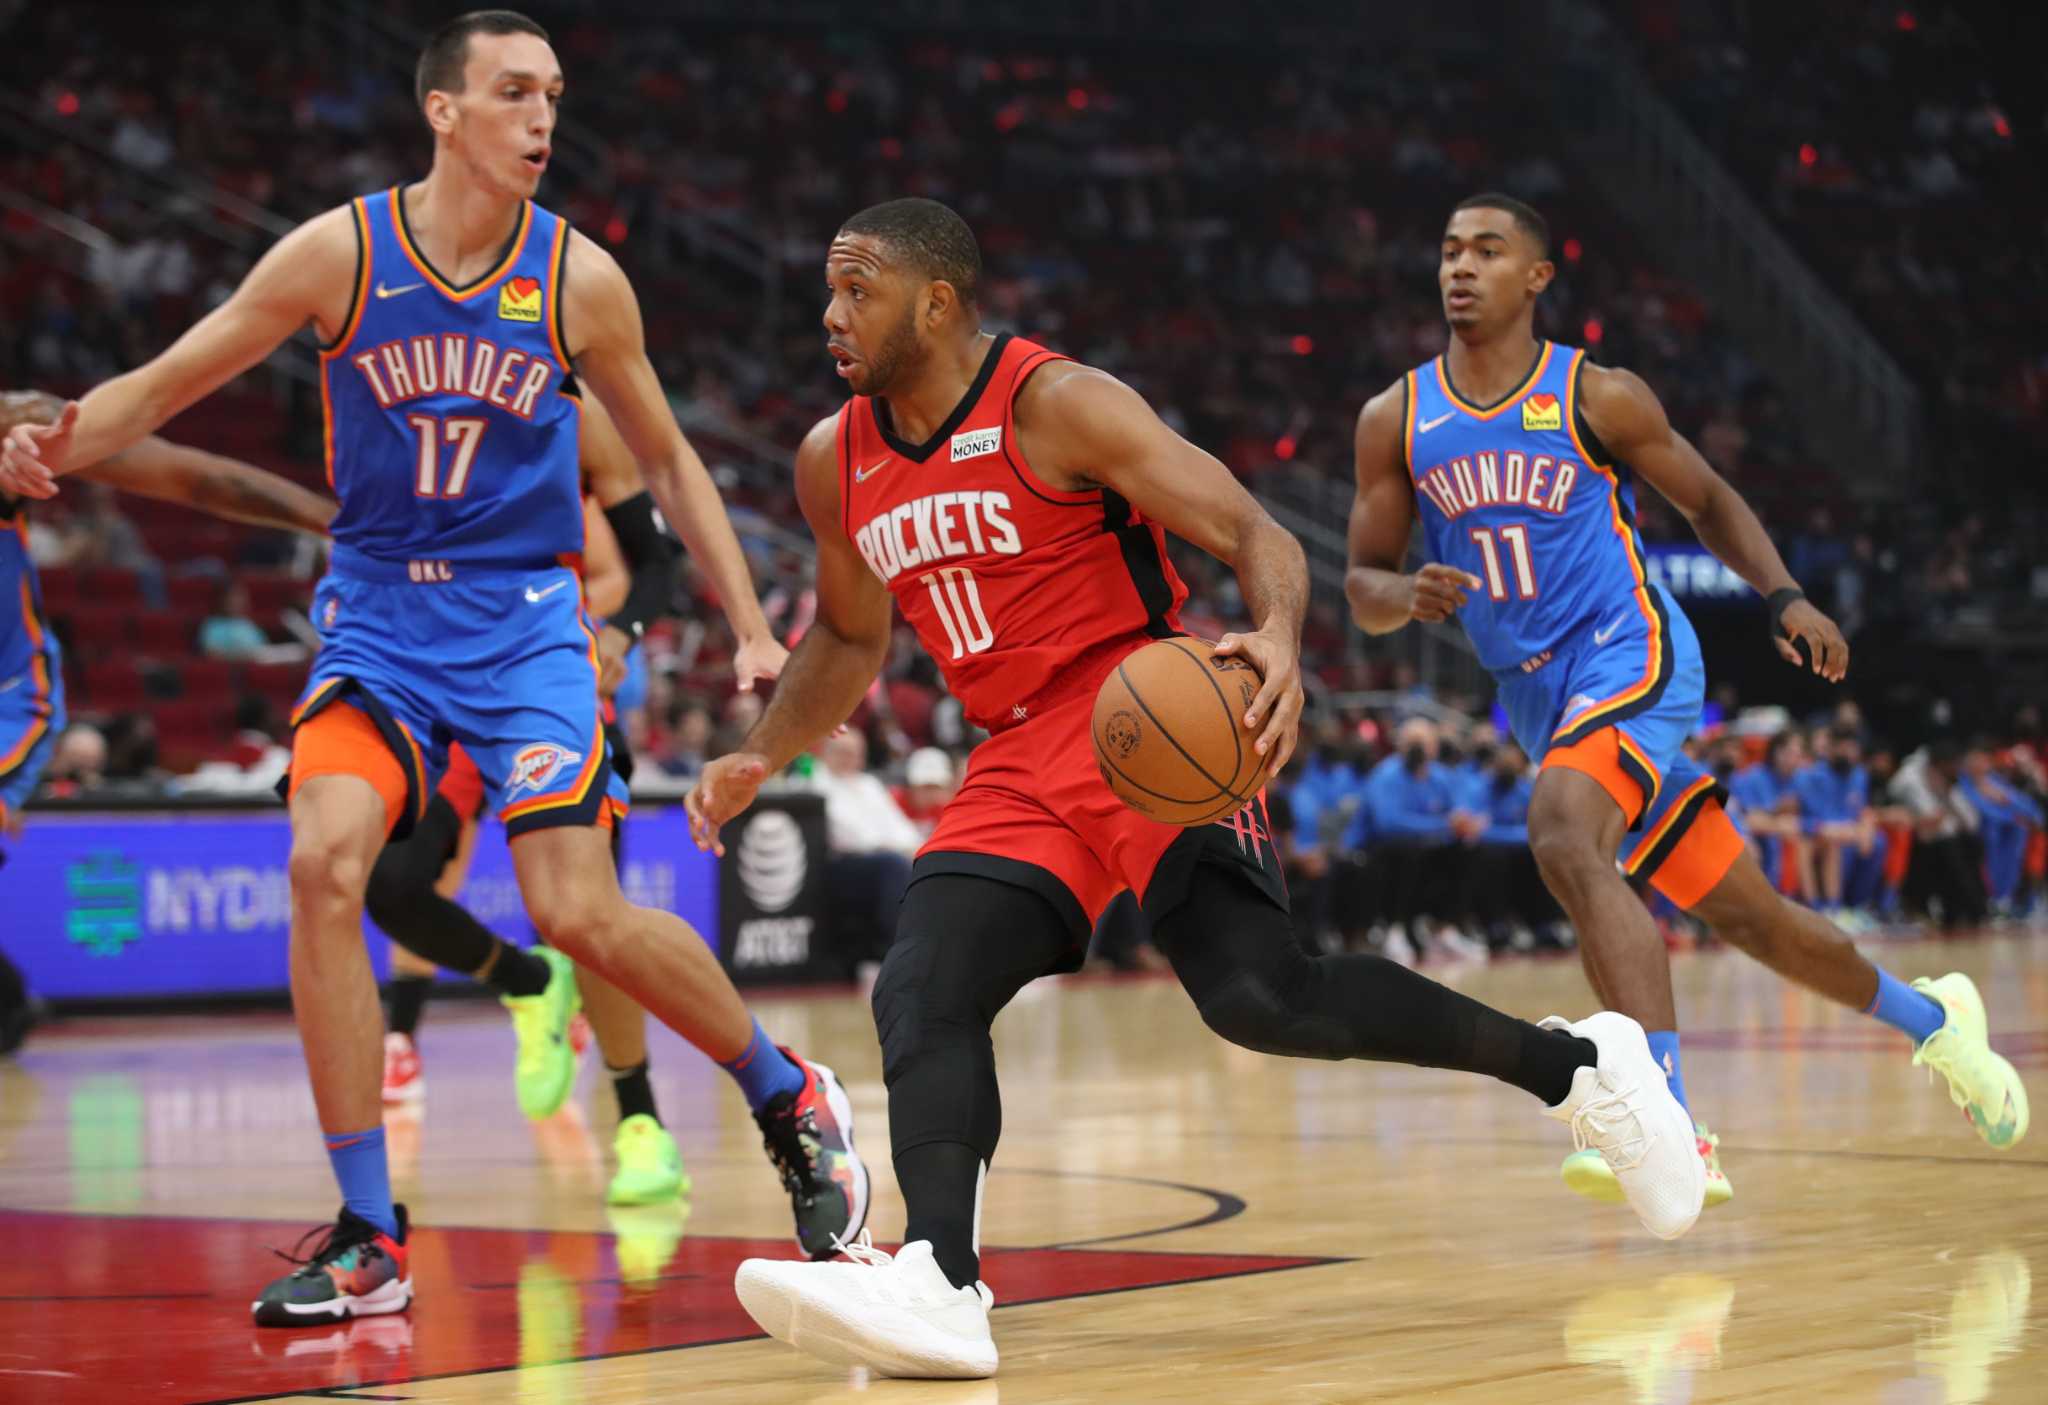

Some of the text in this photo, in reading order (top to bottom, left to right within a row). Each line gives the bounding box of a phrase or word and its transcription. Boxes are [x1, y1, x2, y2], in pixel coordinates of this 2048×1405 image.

[352, 333, 554, 419] THUNDER
[407, 414, 488, 499] 17
[953, 439, 996, 459] MONEY
[1418, 449, 1578, 521] THUNDER
[854, 490, 1023, 584] ROCKETS
[1469, 524, 1537, 602] 11
[919, 566, 994, 660] 10
